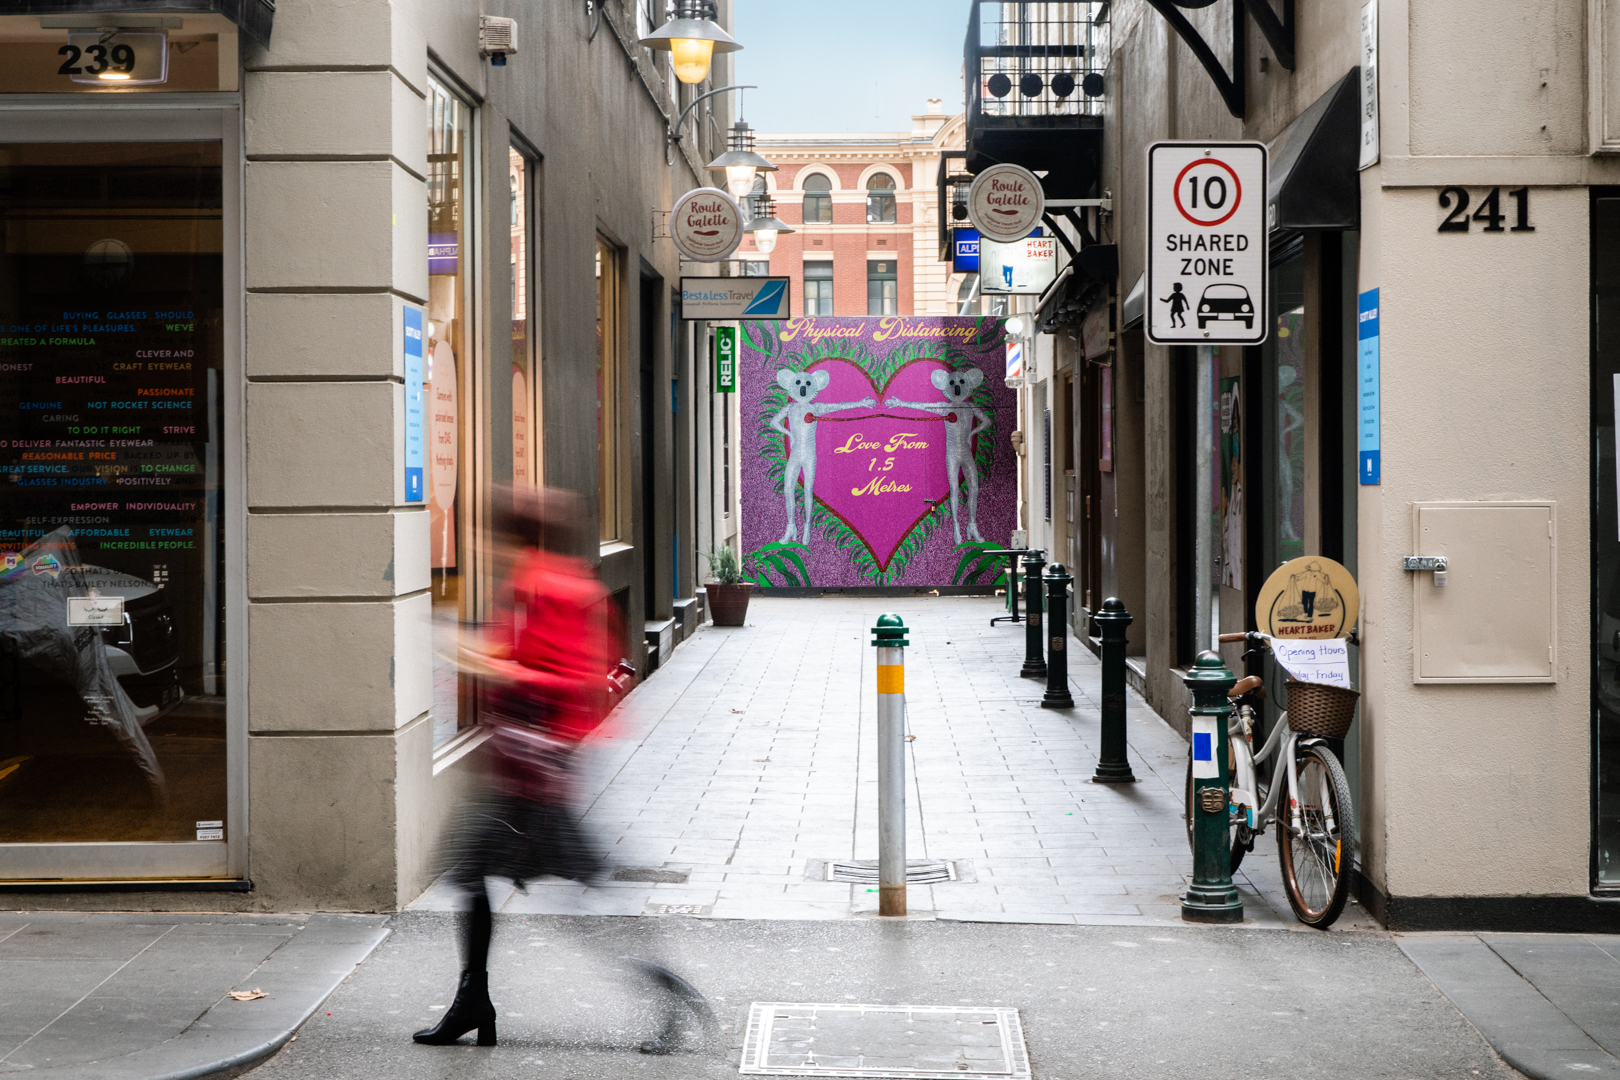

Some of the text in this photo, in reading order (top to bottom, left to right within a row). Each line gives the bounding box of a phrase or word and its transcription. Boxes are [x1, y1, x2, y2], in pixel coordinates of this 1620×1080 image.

[57, 44, 135, 74] 239
[992, 179, 1025, 192] Roule
[1189, 176, 1227, 209] 10
[986, 192, 1030, 206] Galette
[690, 202, 724, 214] Roule
[1438, 187, 1535, 232] 241
[687, 214, 730, 228] Galette
[960, 244, 979, 252] ALP
[1027, 240, 1053, 248] HEART
[1166, 234, 1248, 252] SHARED
[1027, 250, 1054, 258] BAKER
[1180, 258, 1234, 276] ZONE
[728, 290, 754, 300] Travel
[779, 316, 980, 344] Physical Distancing
[720, 338, 732, 386] RELIC
[834, 432, 930, 454] Love From
[868, 457, 896, 472] 1.5
[851, 476, 912, 496] Metres
[1278, 624, 1336, 635] HEART BAKER
[1278, 645, 1346, 661] Opening Hours
